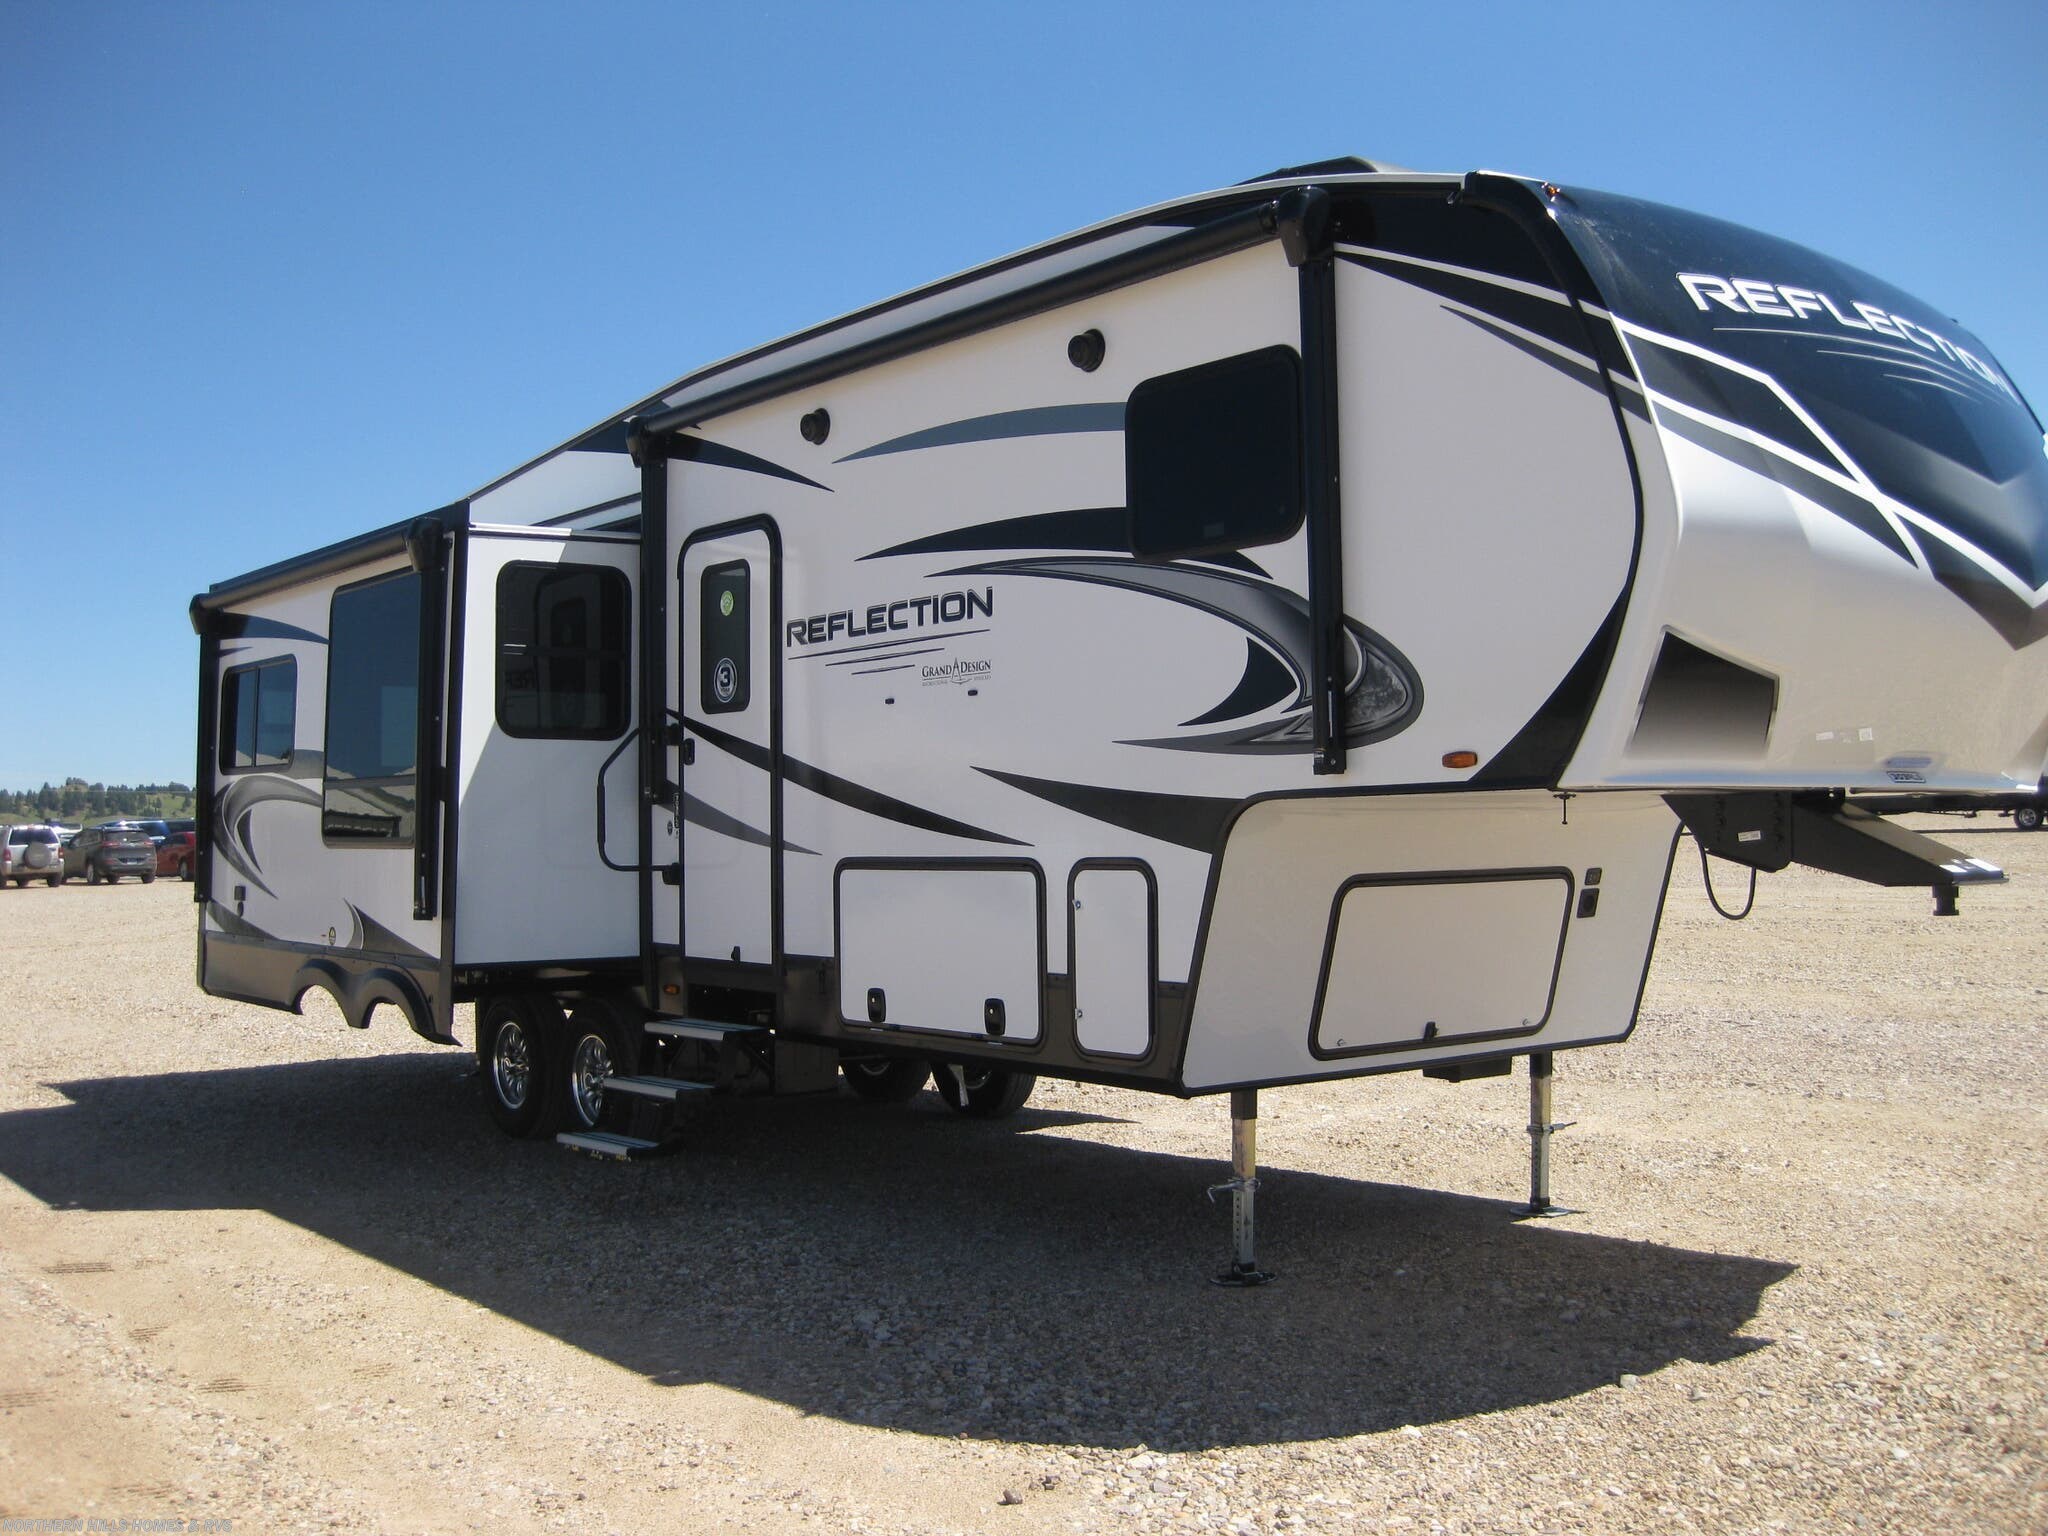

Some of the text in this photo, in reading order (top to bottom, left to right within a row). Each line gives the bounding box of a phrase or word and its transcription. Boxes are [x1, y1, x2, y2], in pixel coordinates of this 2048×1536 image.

[1676, 272, 2021, 404] REFLECTION
[786, 586, 993, 647] REFLECTION
[720, 666, 731, 688] 3
[921, 659, 992, 678] GRAND DESIGN
